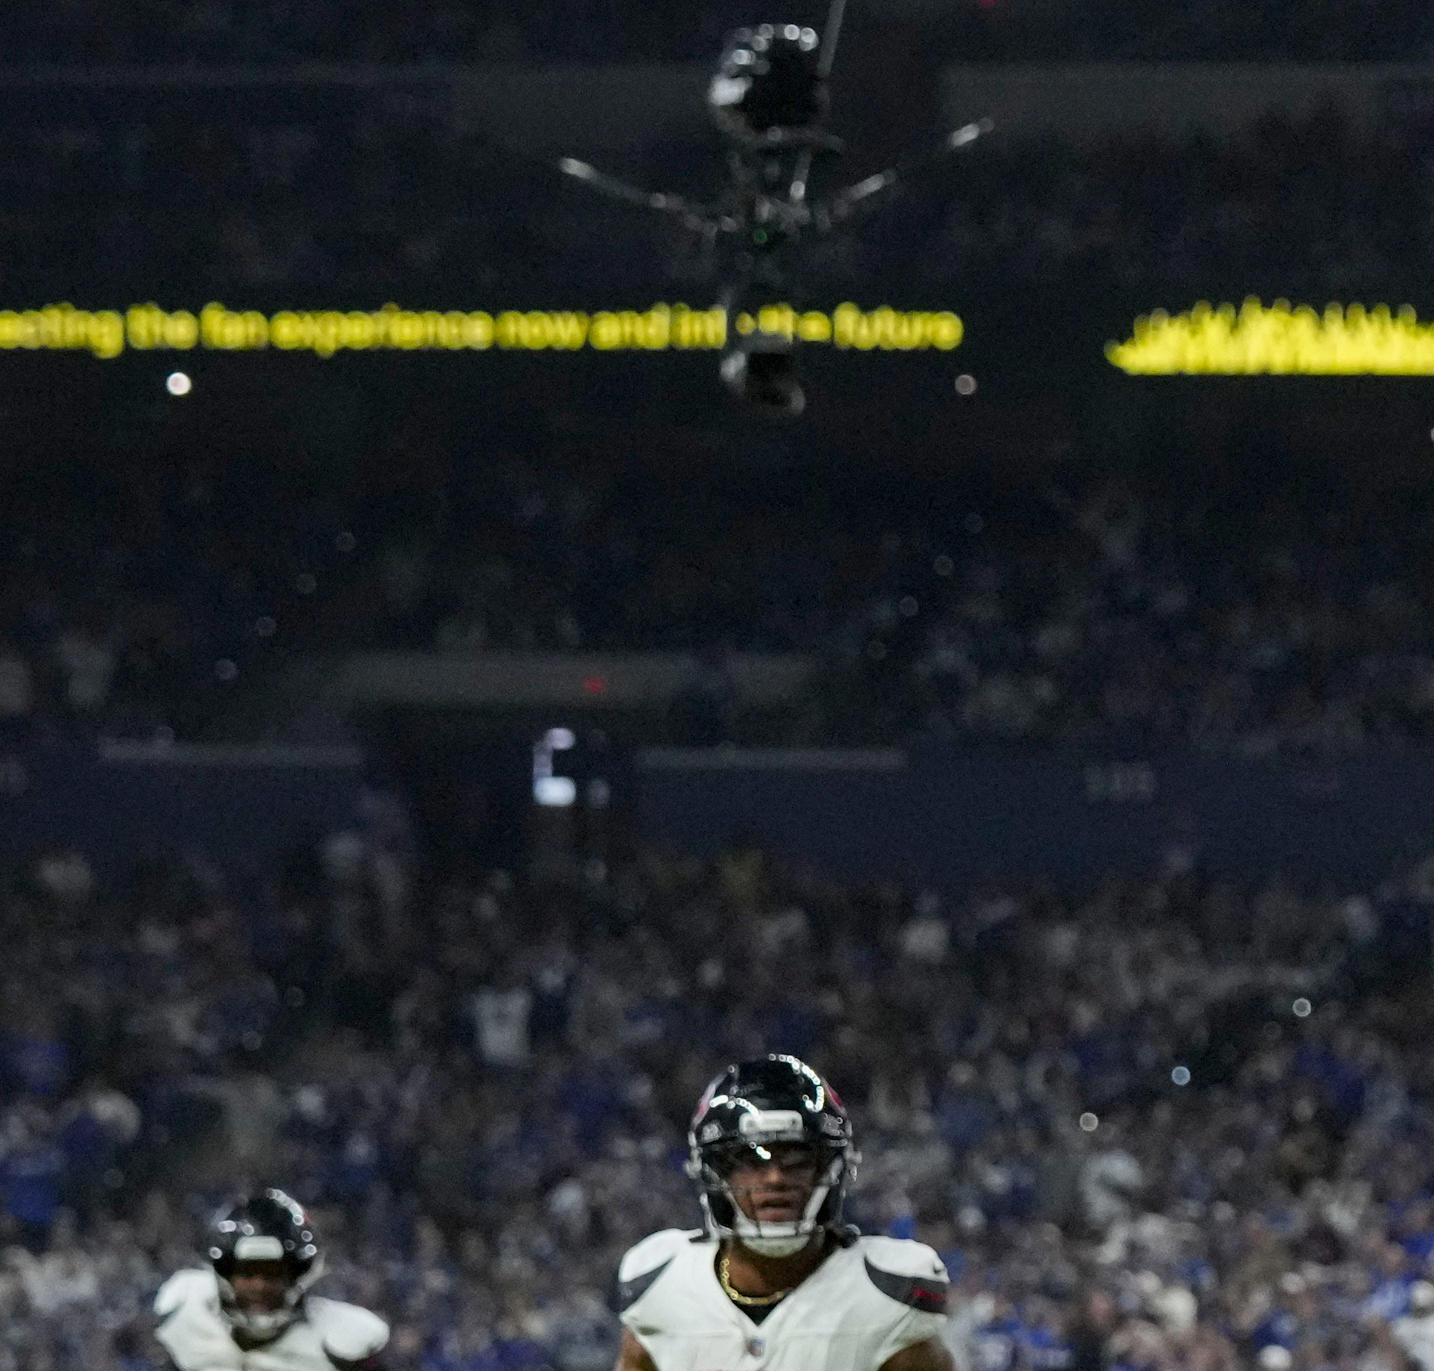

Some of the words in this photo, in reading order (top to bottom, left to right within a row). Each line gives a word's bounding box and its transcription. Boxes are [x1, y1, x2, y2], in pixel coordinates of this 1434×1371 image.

[497, 310, 588, 350] now
[589, 302, 670, 350] and
[833, 300, 964, 351] future
